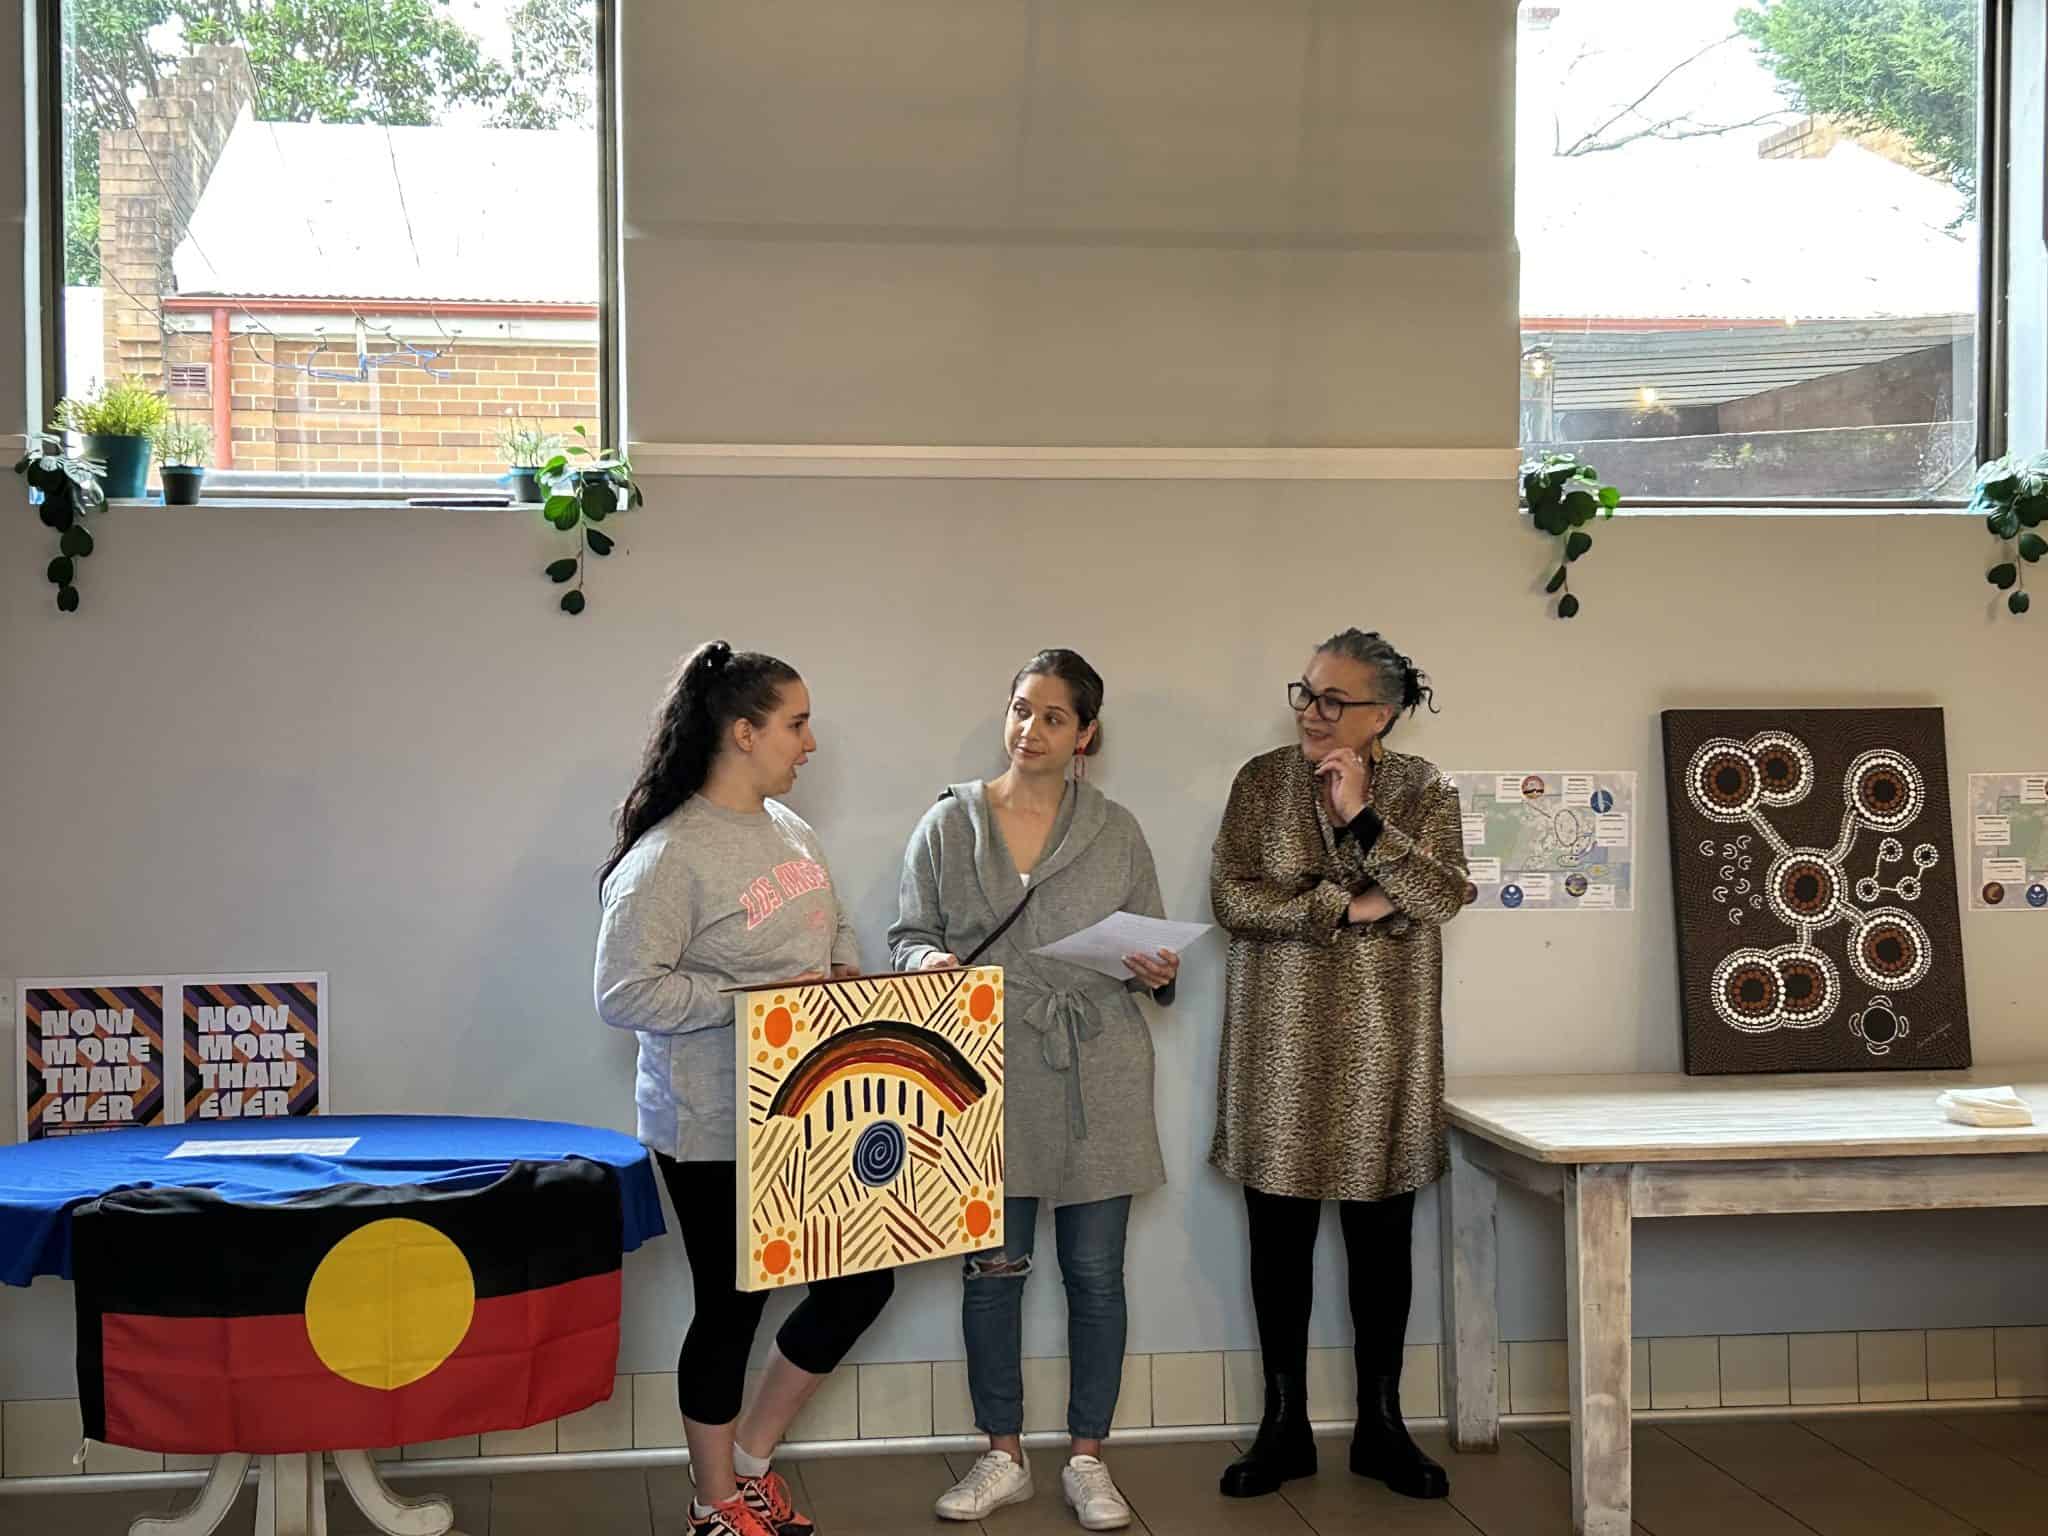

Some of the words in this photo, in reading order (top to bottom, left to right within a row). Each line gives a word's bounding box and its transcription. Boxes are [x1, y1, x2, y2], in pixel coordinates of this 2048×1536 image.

[41, 1008, 134, 1036] NOW
[198, 1005, 289, 1033] NOW
[41, 1036, 150, 1064] MORE
[198, 1033, 305, 1061] MORE
[41, 1065, 142, 1093] THAN
[198, 1061, 297, 1089] THAN
[43, 1094, 134, 1122] EVER
[199, 1090, 289, 1118] EVER
